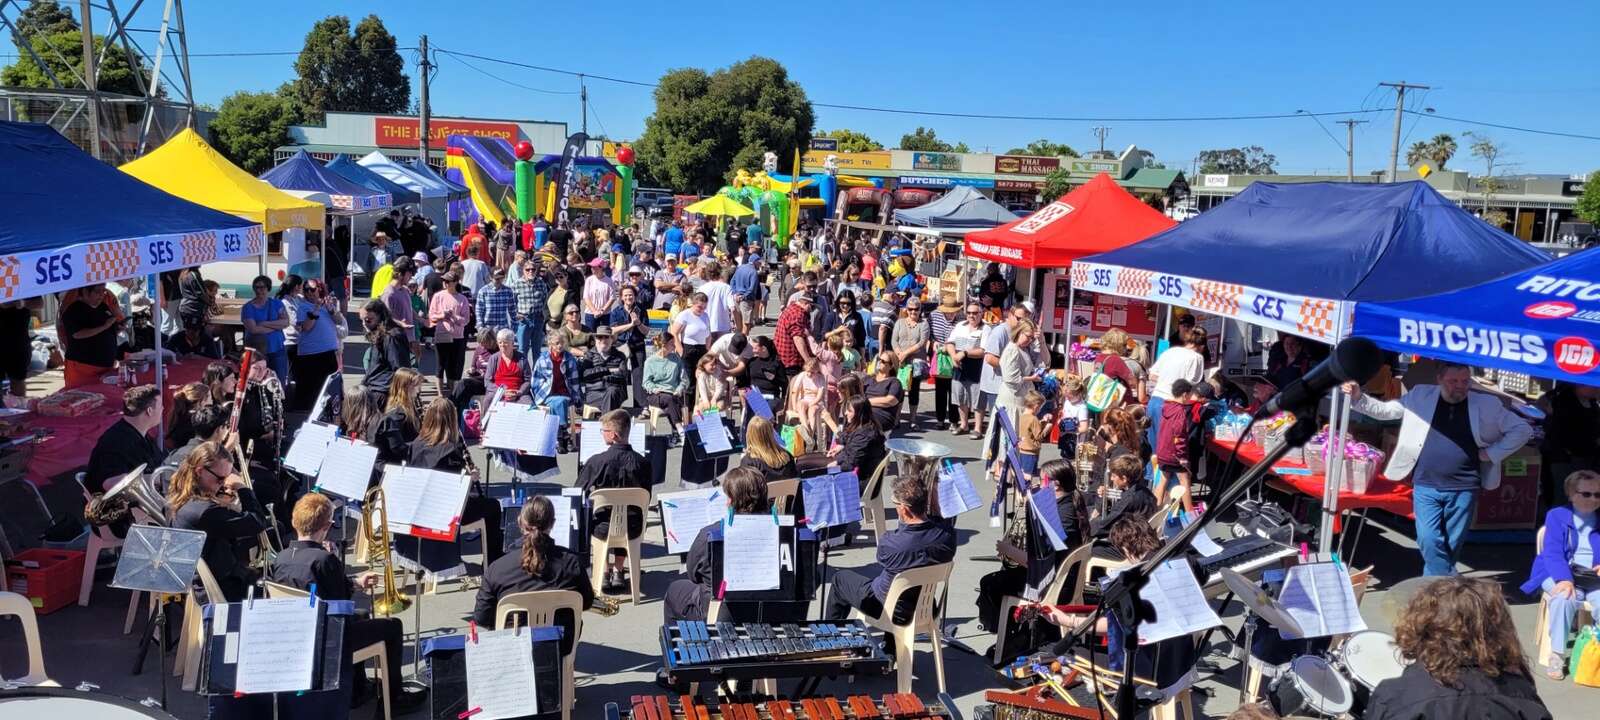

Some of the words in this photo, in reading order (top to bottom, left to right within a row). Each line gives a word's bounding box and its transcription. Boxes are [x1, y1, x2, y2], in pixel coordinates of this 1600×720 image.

[383, 125, 411, 138] THE
[1021, 158, 1040, 166] THAI
[558, 144, 579, 222] TATTOO
[900, 176, 951, 185] BUTCHER
[35, 253, 72, 285] SES
[149, 241, 174, 266] SES
[223, 232, 241, 253] SES
[1000, 246, 1024, 260] BRIGADE
[1093, 269, 1112, 287] SES
[1158, 275, 1183, 298] SES
[1252, 294, 1287, 321] SES
[1529, 304, 1572, 317] IGA
[1399, 317, 1548, 365] RITCHIES
[1557, 343, 1594, 366] IGA
[780, 543, 794, 572] A
